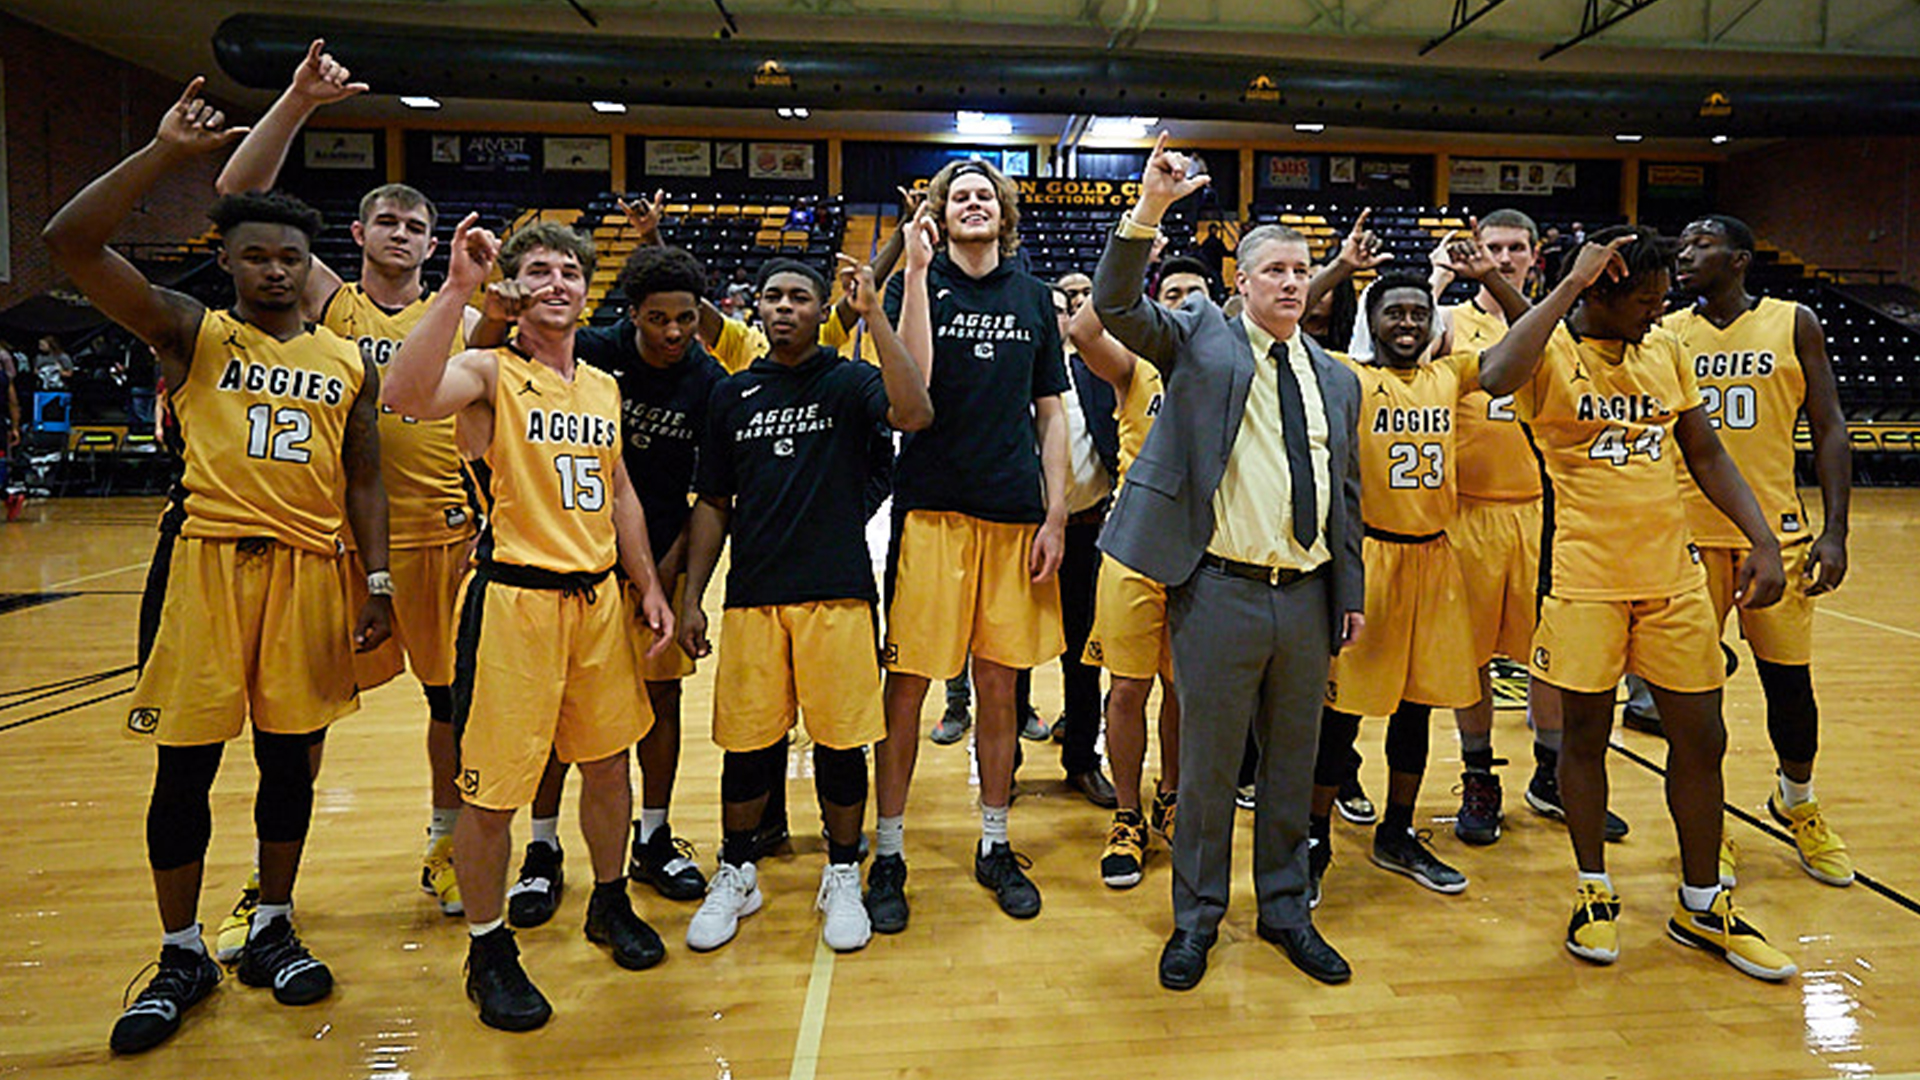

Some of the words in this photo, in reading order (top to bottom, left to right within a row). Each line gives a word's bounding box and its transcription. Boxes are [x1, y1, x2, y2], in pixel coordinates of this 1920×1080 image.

[467, 136, 526, 154] ARVEST
[1025, 194, 1104, 206] SECTIONS
[1046, 181, 1112, 196] GOLD
[937, 325, 1032, 342] BASKETBALL
[951, 312, 1017, 330] AGGIE
[1694, 350, 1776, 379] GGIES
[218, 357, 344, 408] AGGIES
[622, 399, 686, 426] AGGIE
[749, 402, 820, 427] AGGIE
[1371, 405, 1451, 434] AGGIES
[246, 402, 312, 465] 12
[526, 408, 618, 450] AGGIES
[735, 416, 834, 442] BASKETBALL
[1587, 423, 1666, 466] 44
[1388, 441, 1446, 490] 23
[553, 453, 606, 513] 15
